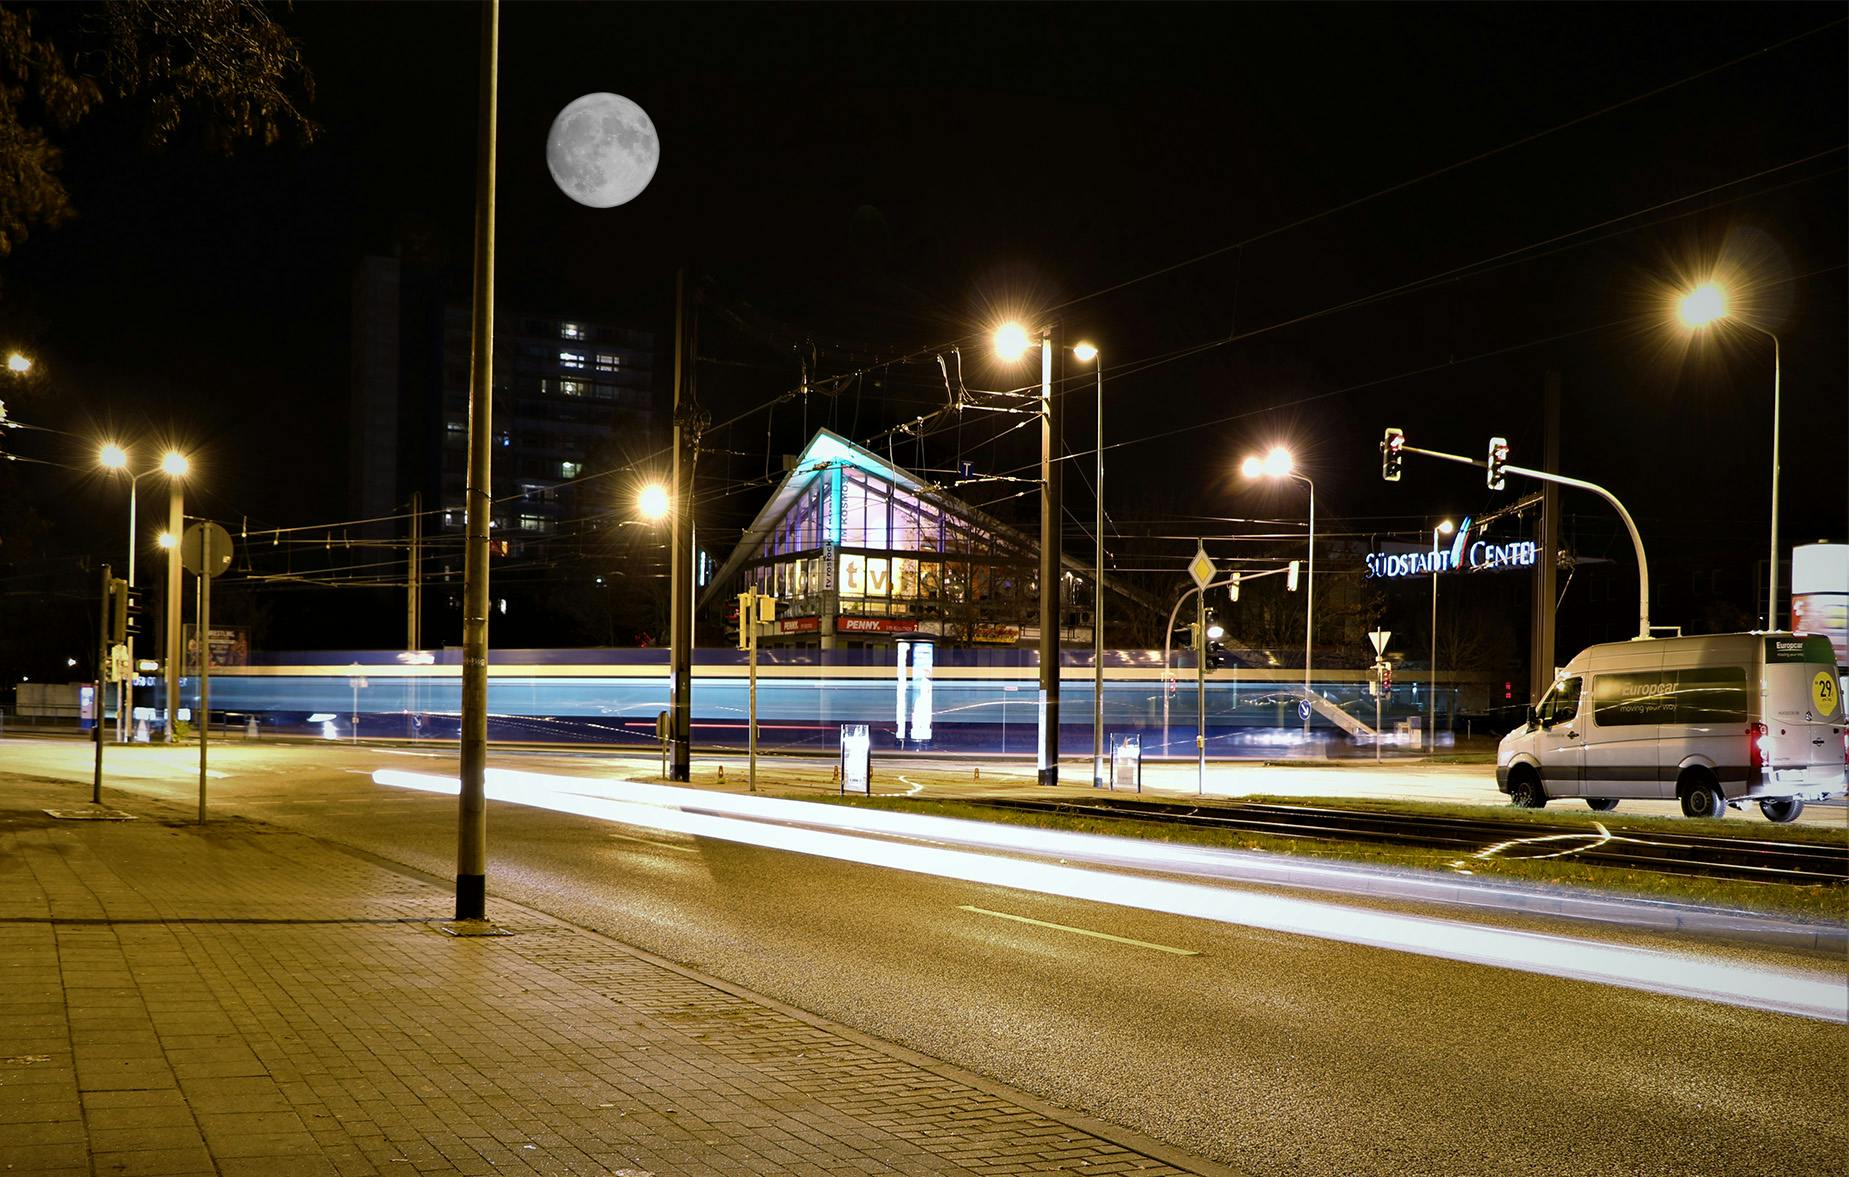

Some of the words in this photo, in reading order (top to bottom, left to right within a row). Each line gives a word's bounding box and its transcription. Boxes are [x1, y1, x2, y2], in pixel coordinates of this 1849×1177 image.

[825, 539, 833, 576] rostock
[1364, 550, 1451, 579] SÜDSTADT
[1775, 641, 1804, 650] Europcar
[1622, 682, 1679, 697] Europcar
[1819, 680, 1832, 698] 29
[1620, 704, 1644, 714] moving
[1645, 705, 1661, 713] your
[1662, 703, 1678, 713] way
